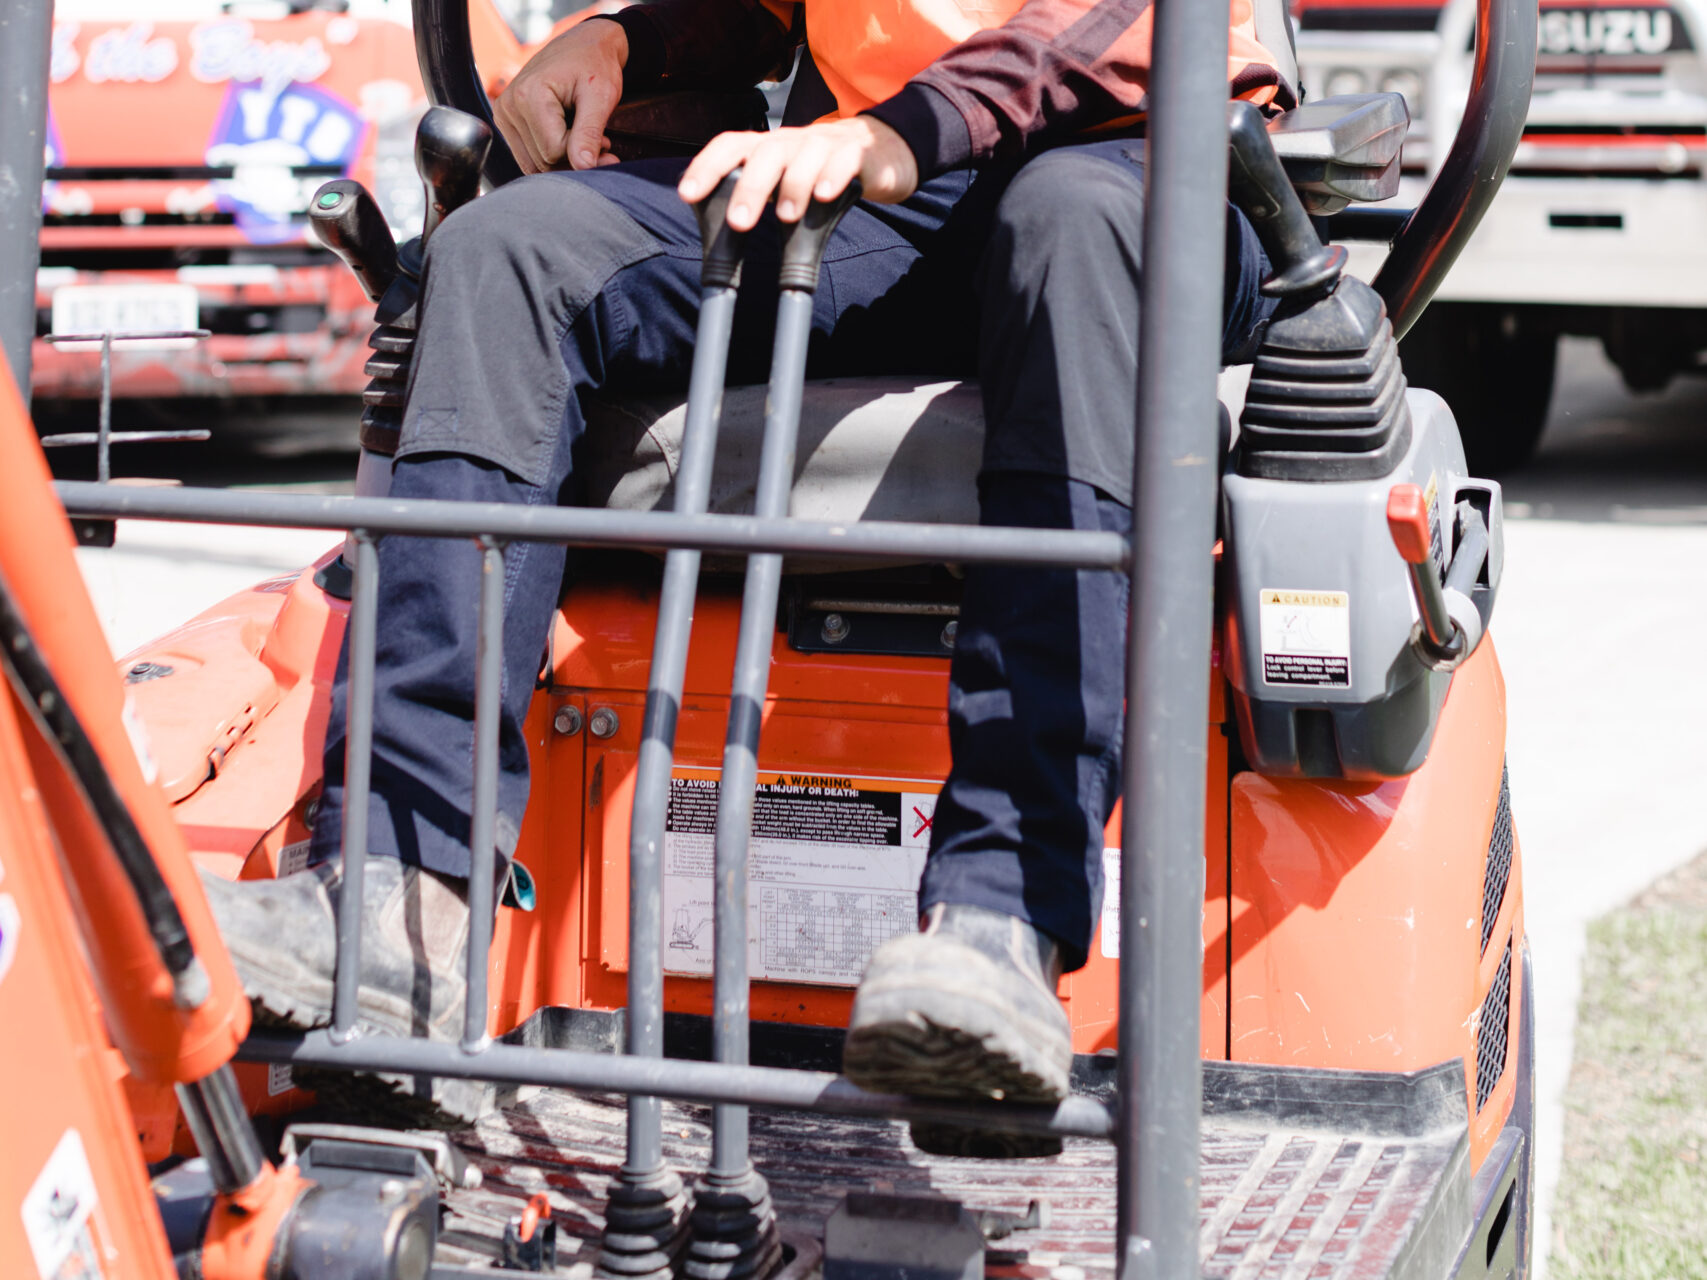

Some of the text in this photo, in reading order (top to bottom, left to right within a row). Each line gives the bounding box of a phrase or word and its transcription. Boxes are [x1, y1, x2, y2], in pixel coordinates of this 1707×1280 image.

[1284, 594, 1340, 605] CAUTION
[687, 780, 716, 788] AVOID
[770, 785, 806, 794] INJURY
[808, 787, 822, 796] OR
[791, 776, 852, 788] WARNING
